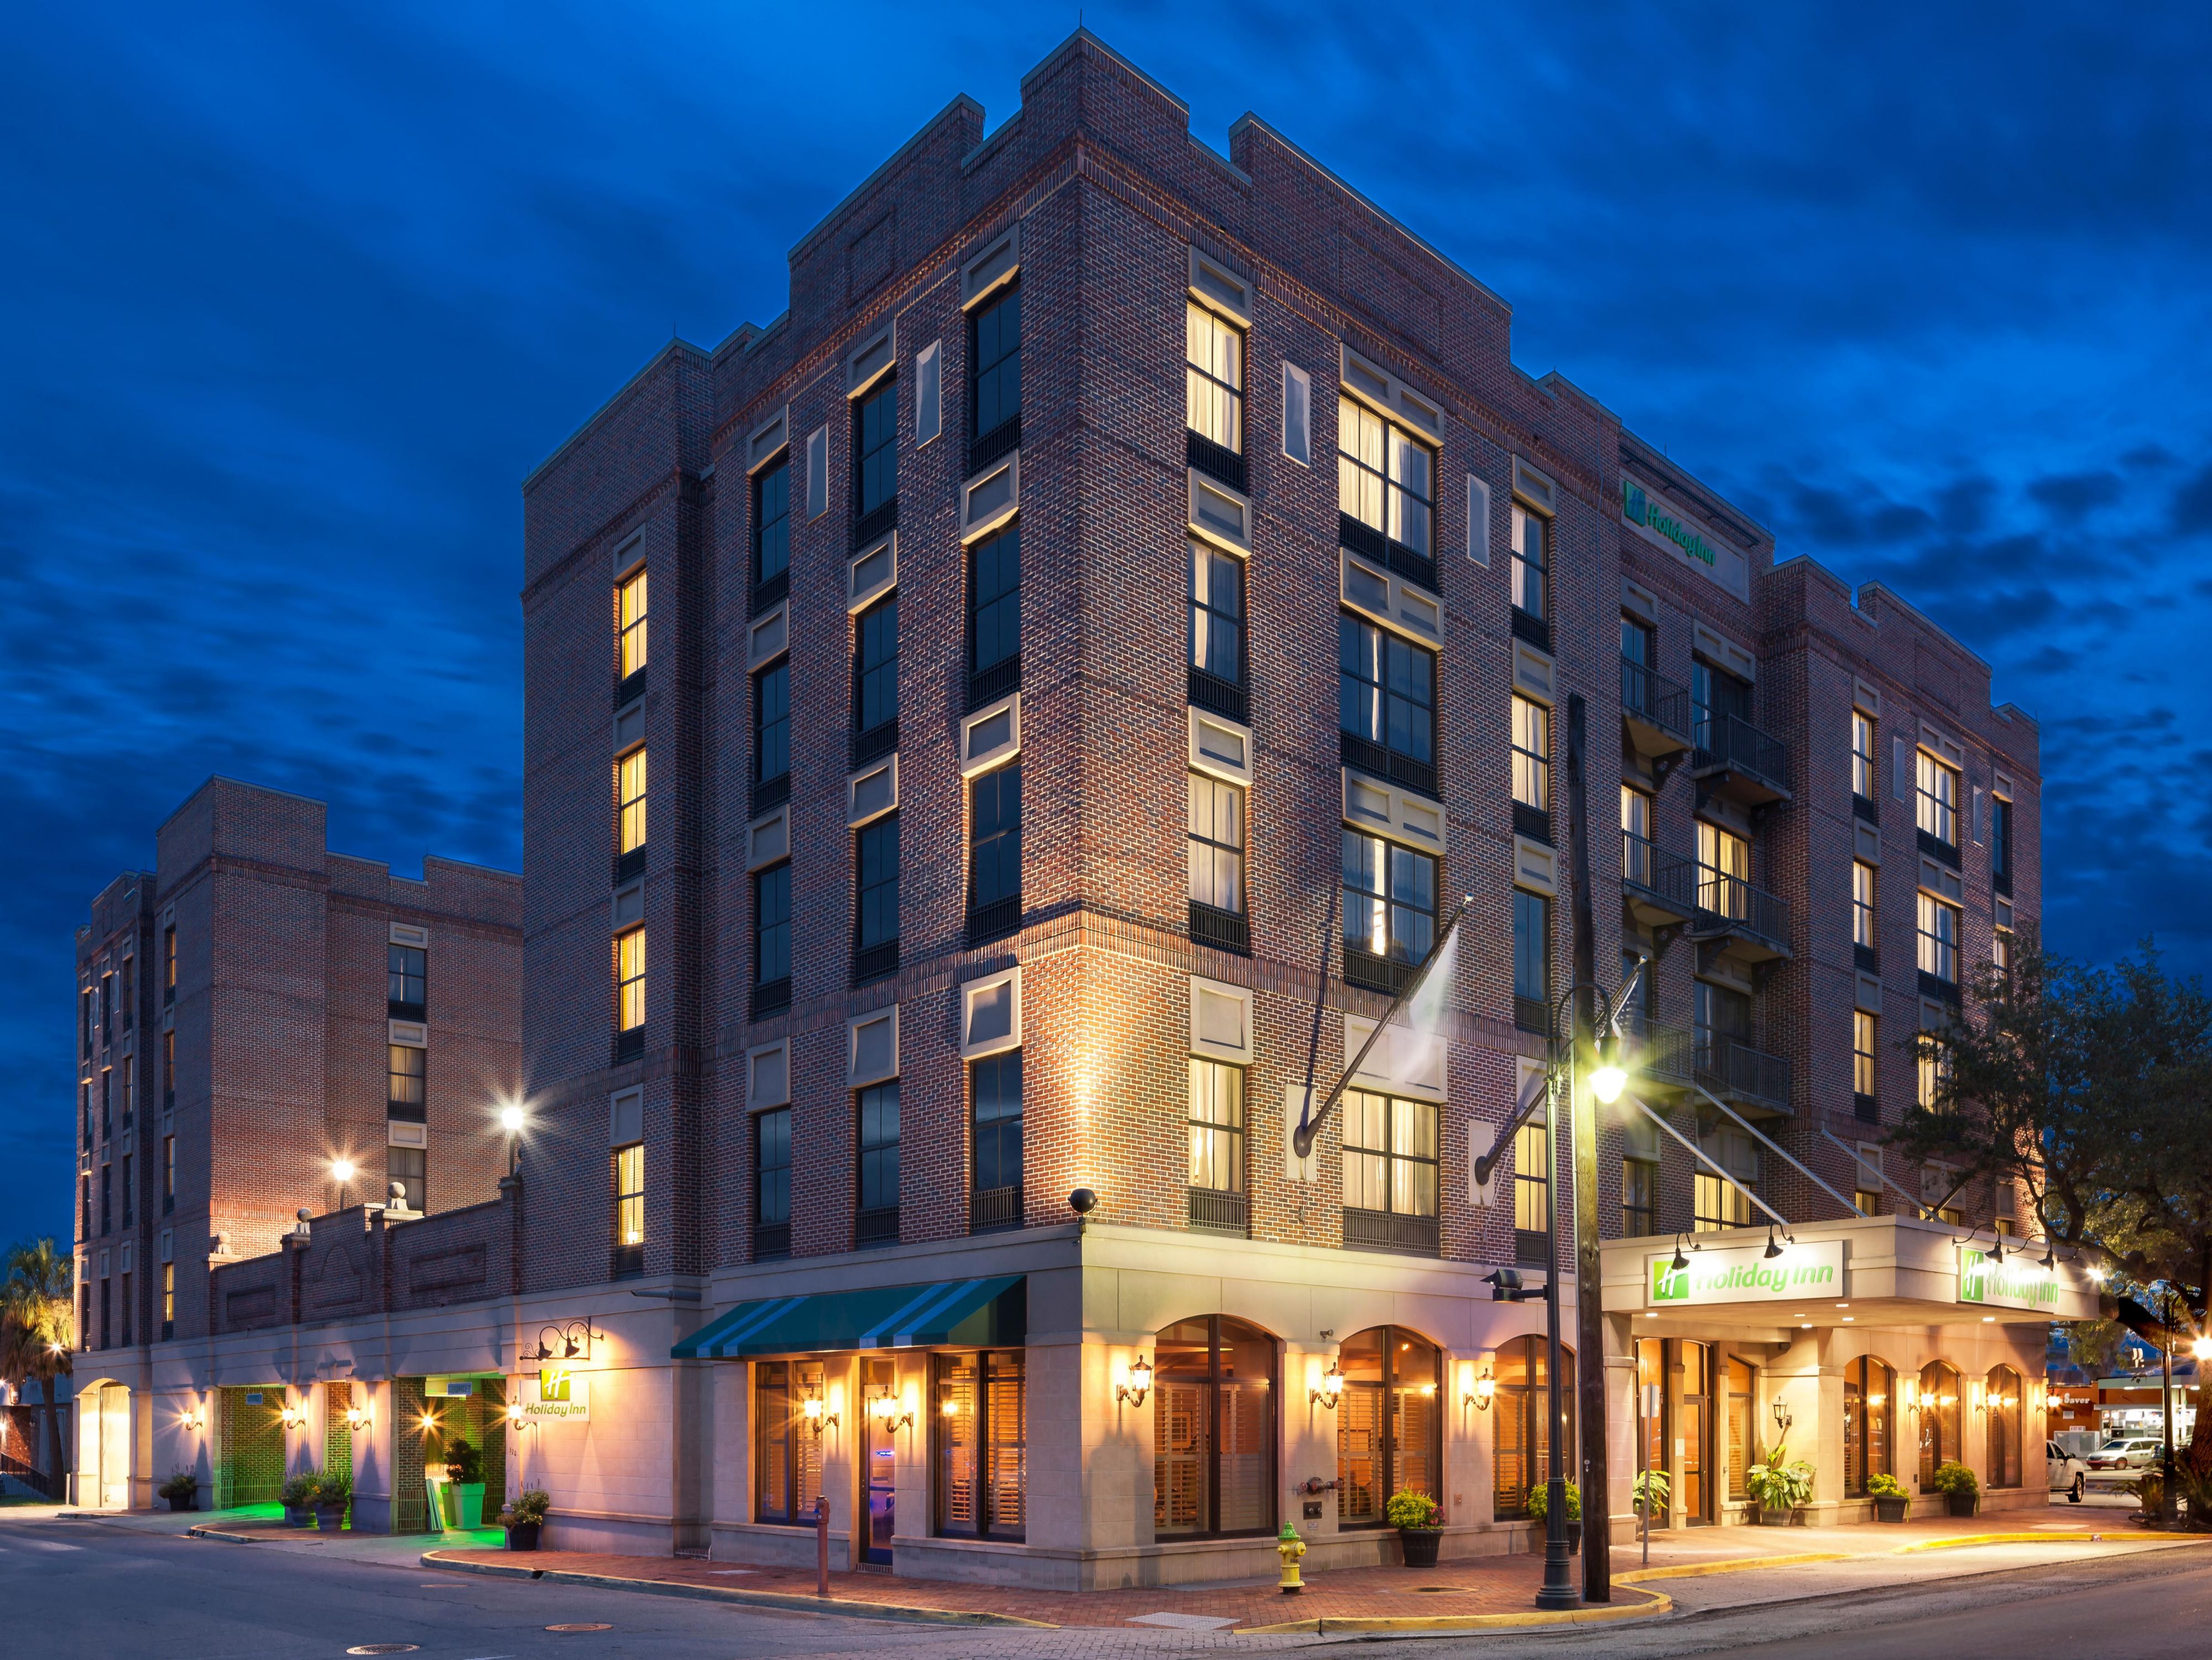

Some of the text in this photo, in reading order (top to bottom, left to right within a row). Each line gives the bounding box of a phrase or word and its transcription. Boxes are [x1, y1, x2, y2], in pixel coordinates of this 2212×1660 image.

[1648, 503, 1715, 567] Holiday Inn
[1792, 1262, 1833, 1284] Inn
[2039, 1277, 2059, 1303] Inn
[2064, 1392, 2090, 1404] Saver
[525, 1402, 586, 1417] Holiday Inn
